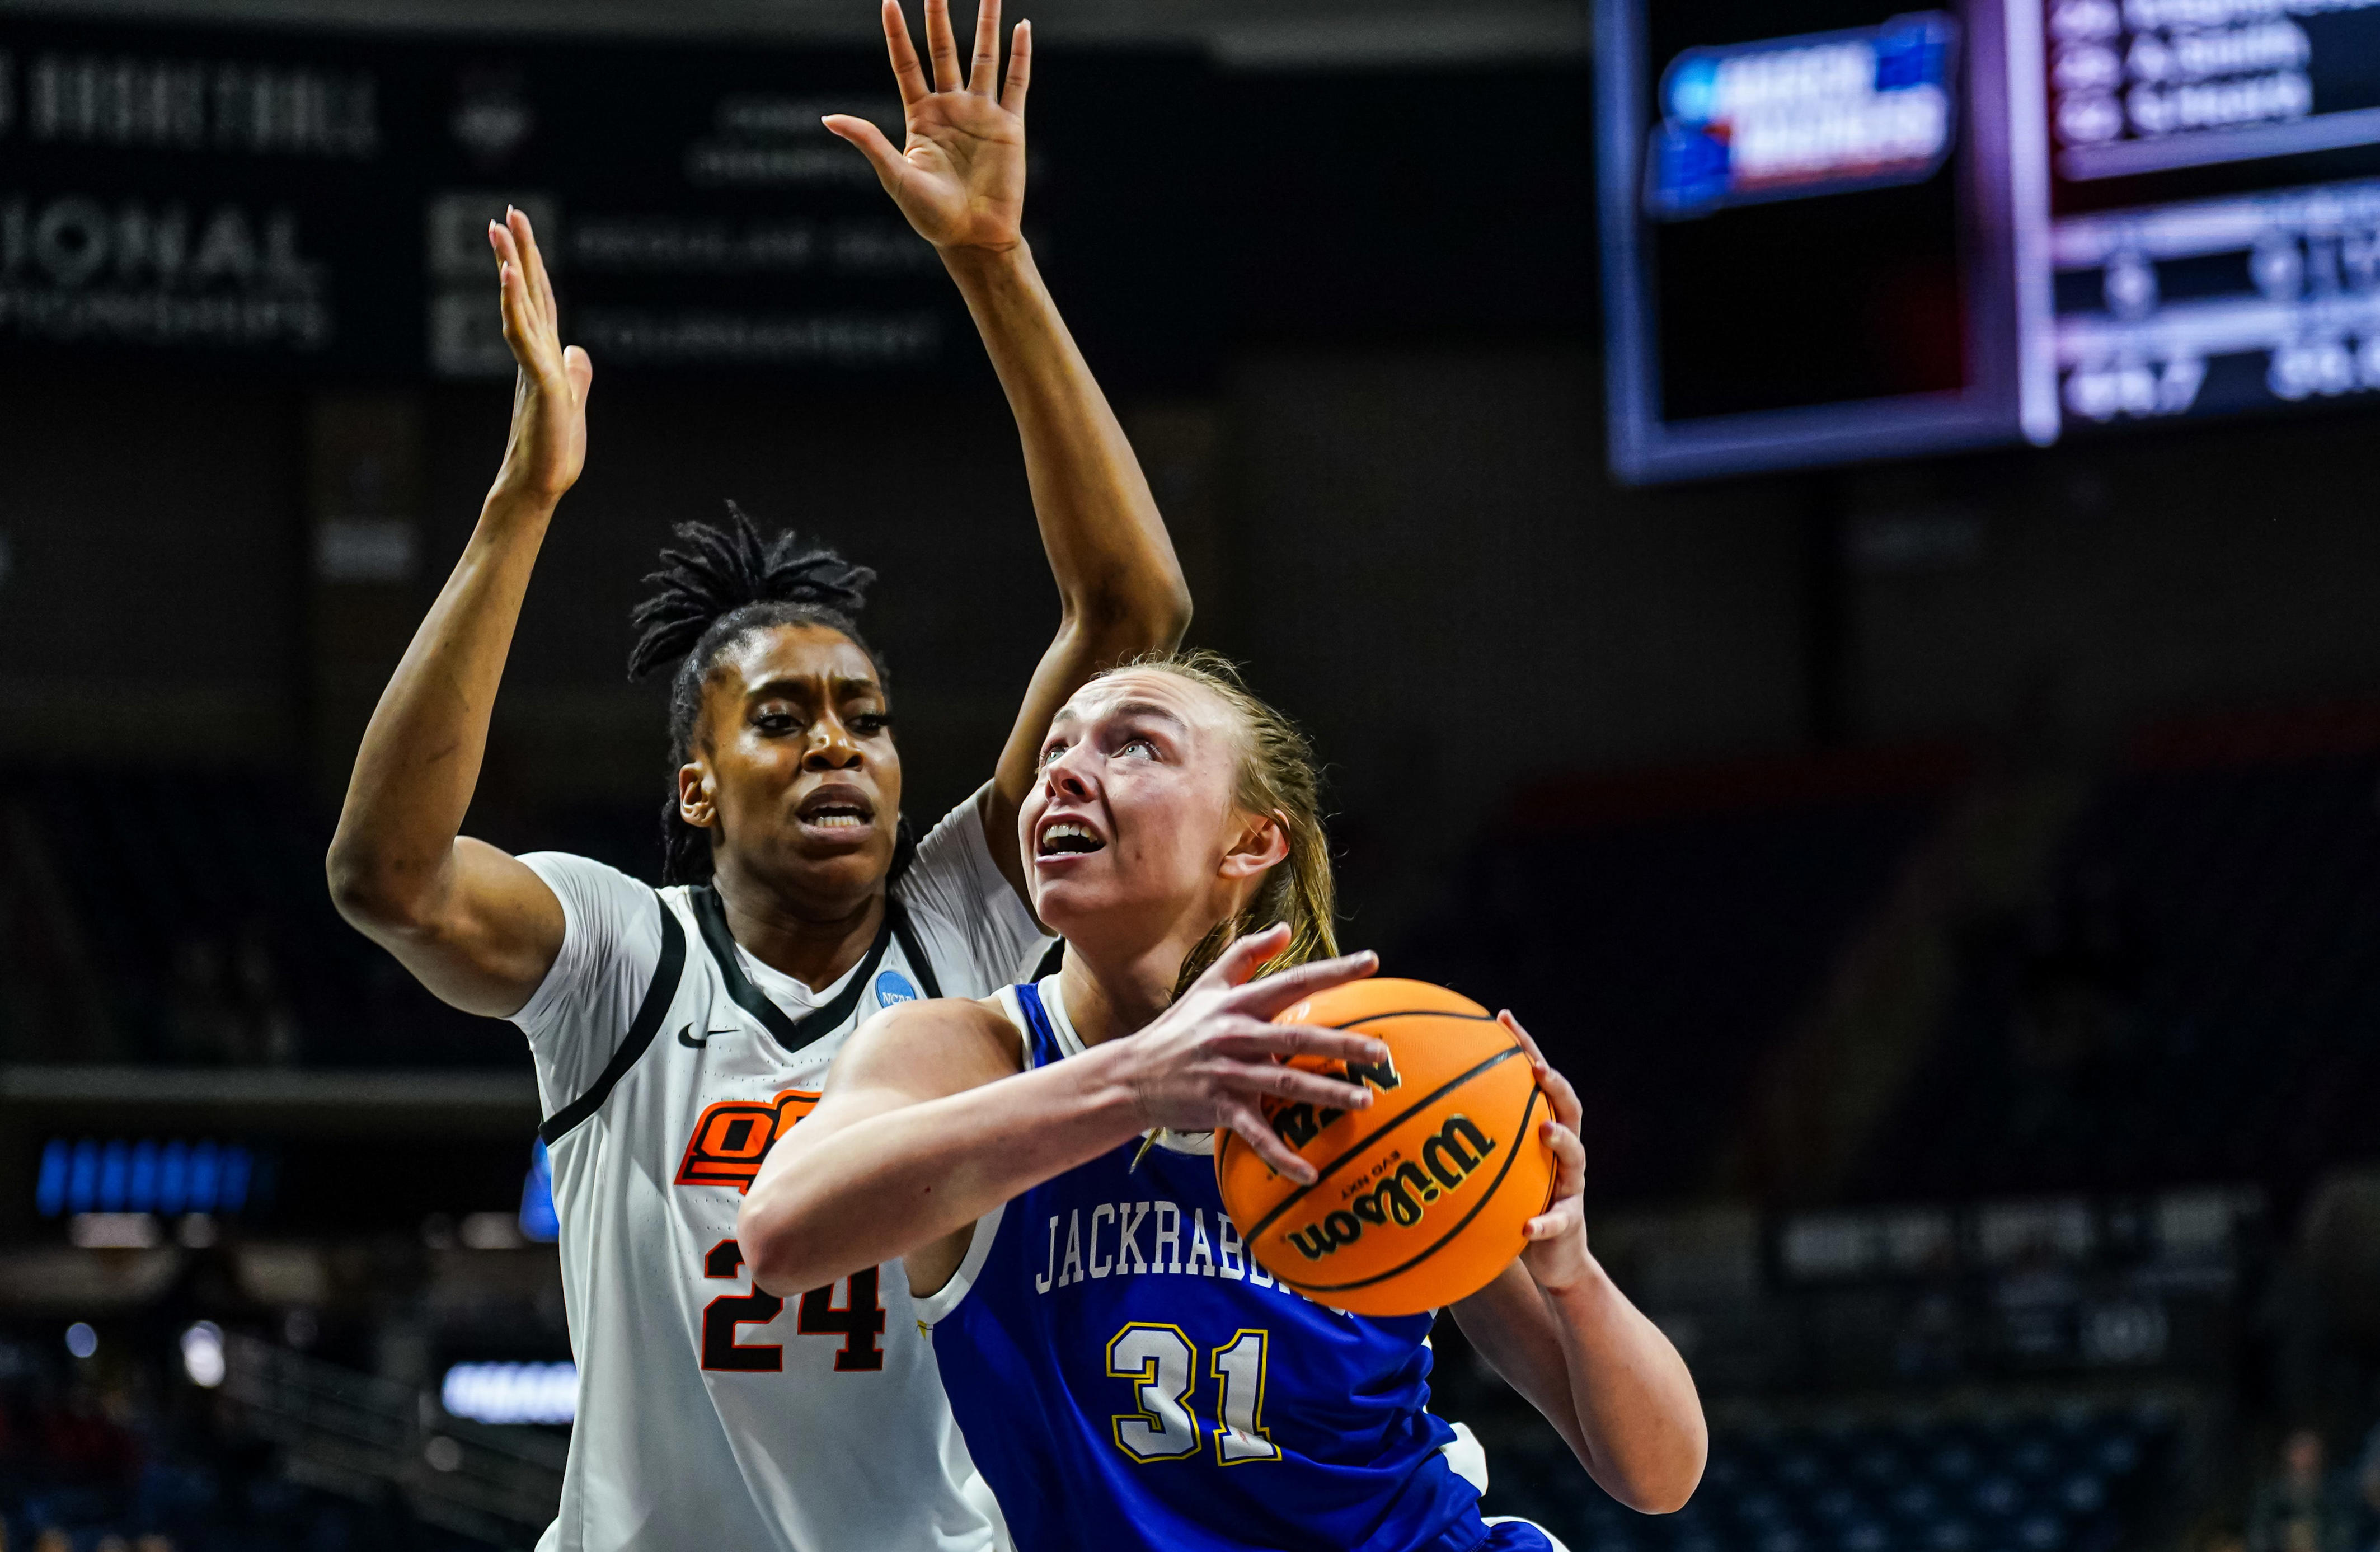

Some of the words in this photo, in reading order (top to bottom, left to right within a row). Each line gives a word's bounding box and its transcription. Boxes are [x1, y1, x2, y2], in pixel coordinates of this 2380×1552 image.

[1288, 1113, 1496, 1261] Wilson
[701, 1239, 886, 1372] 24
[1035, 1200, 1346, 1316] JACKRAB
[1106, 1321, 1283, 1467] 31
